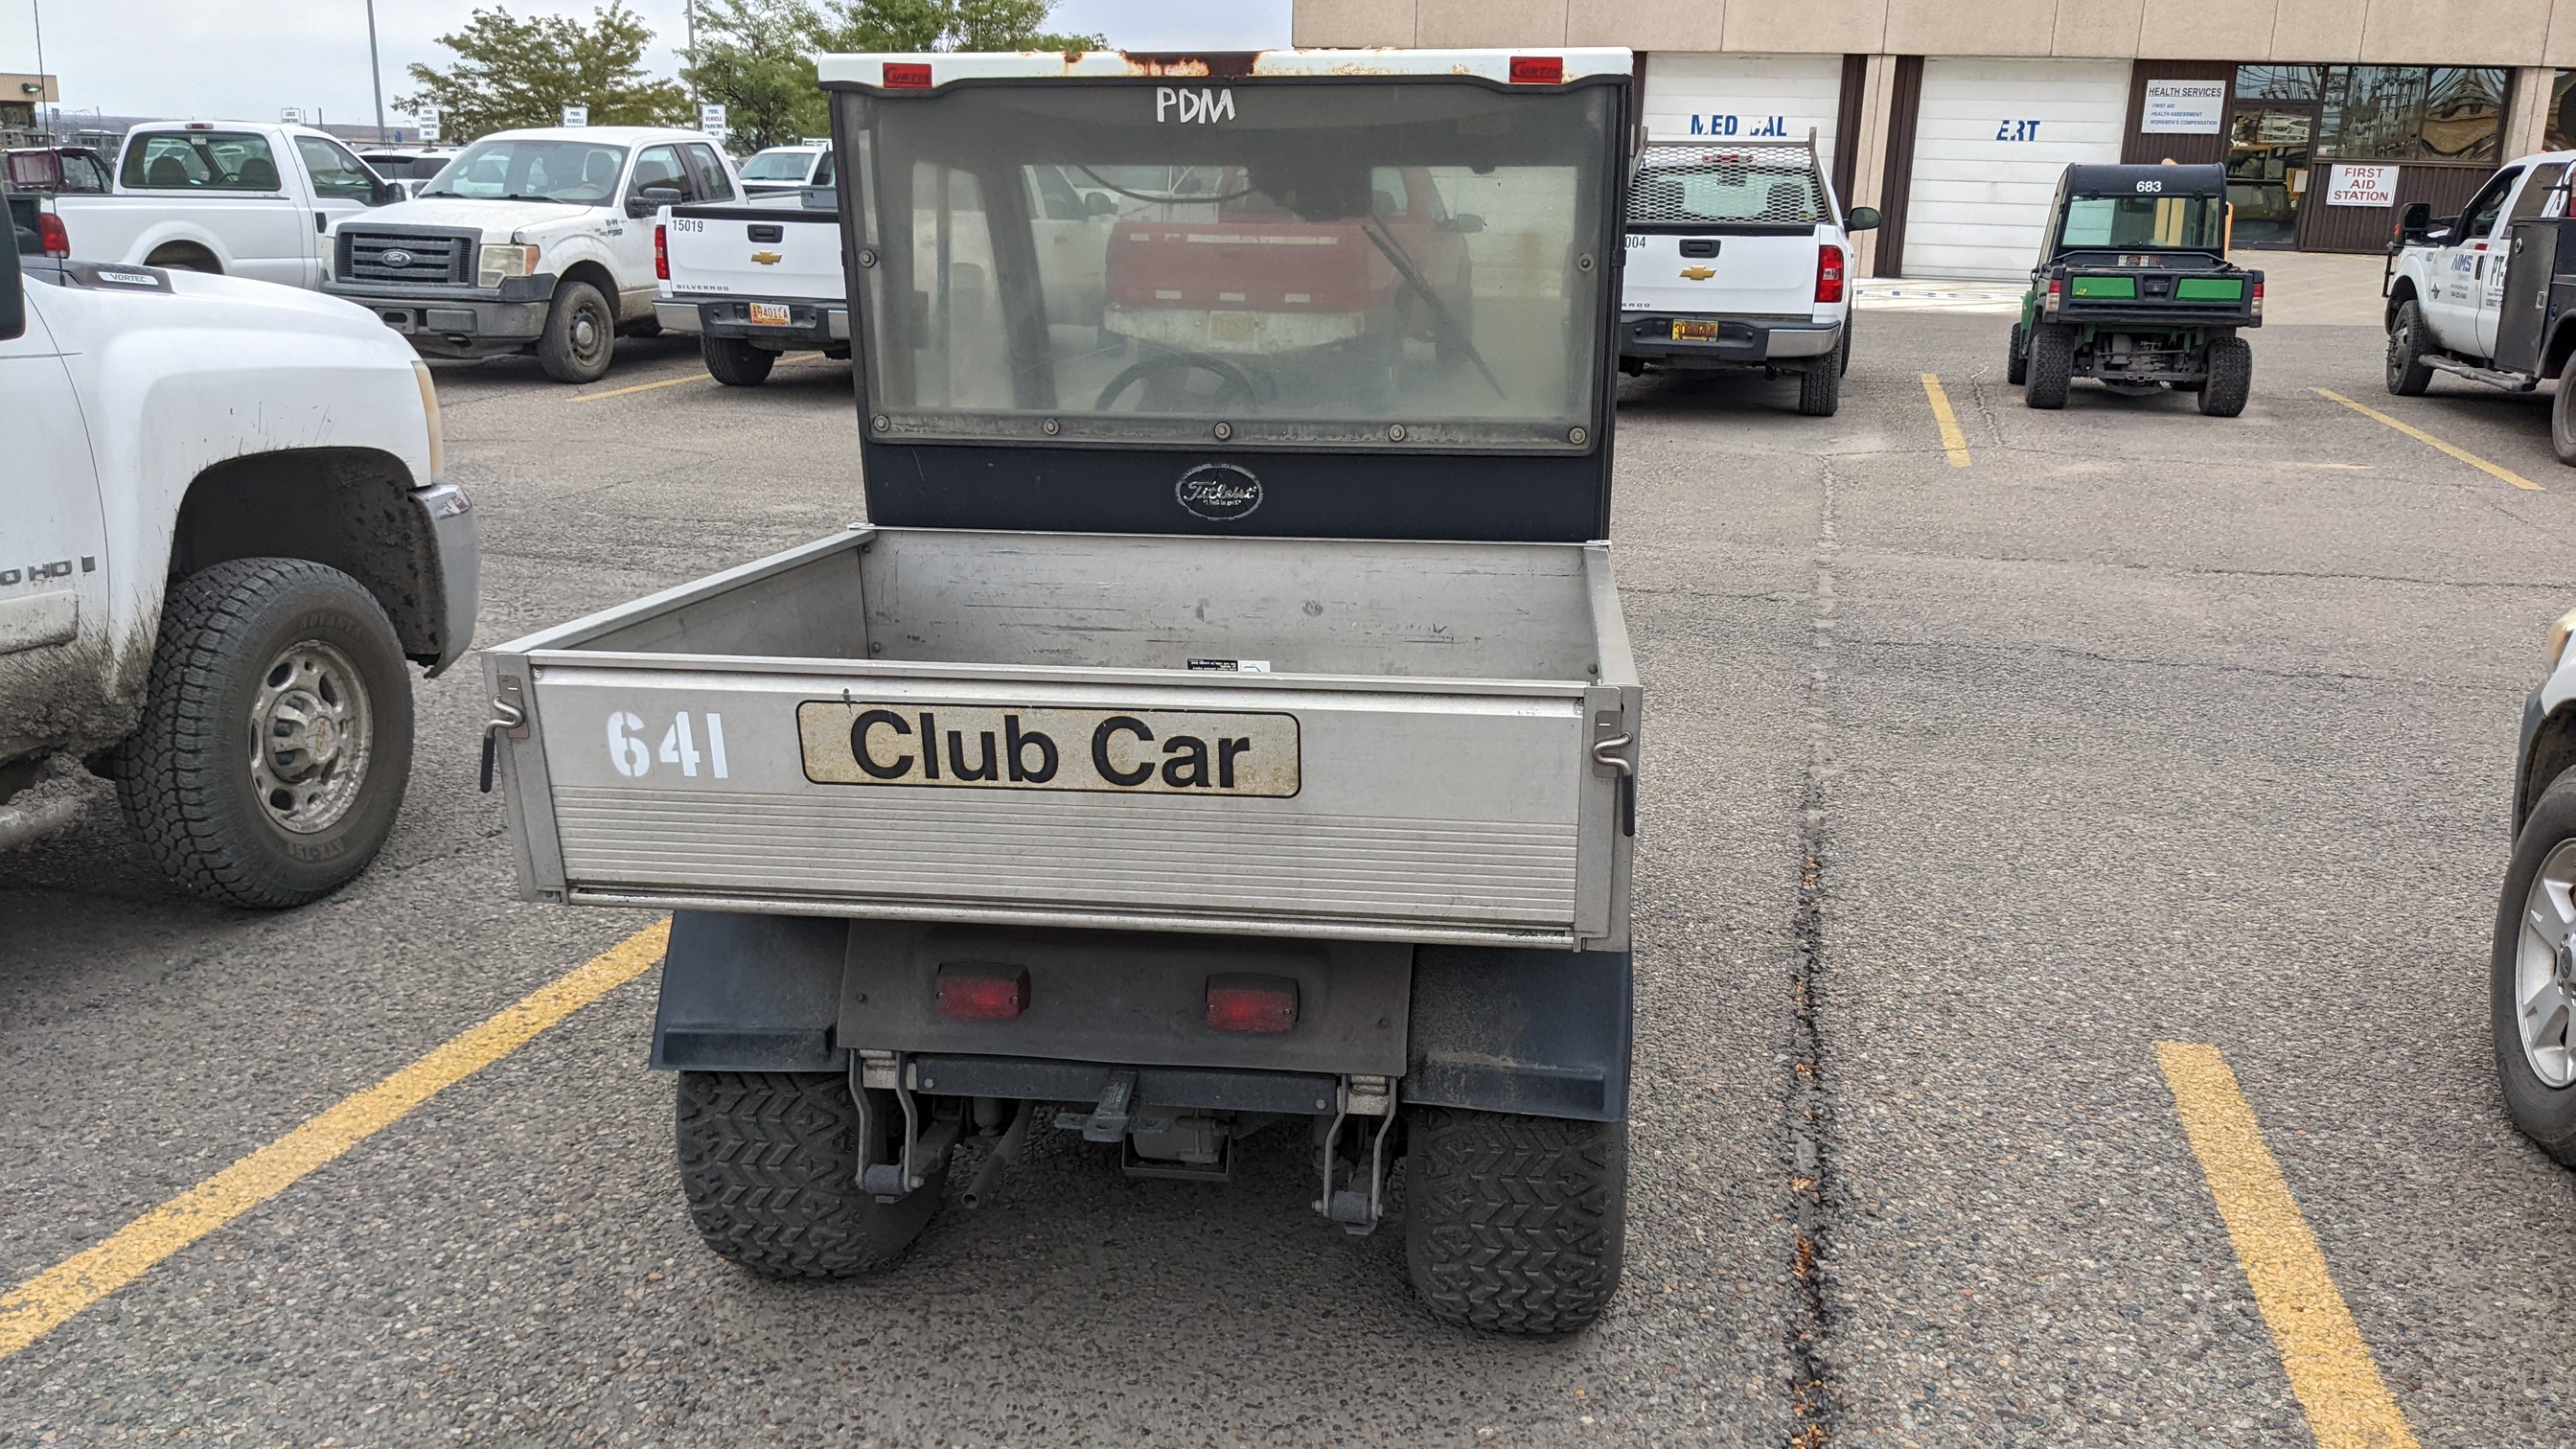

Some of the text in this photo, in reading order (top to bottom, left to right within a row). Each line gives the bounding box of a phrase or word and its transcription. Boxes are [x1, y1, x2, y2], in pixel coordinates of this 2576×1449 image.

[2149, 87, 2222, 97] HEALTH SERVICES
[1157, 86, 1235, 125] PDM
[2345, 168, 2384, 178] FIRST
[2136, 180, 2162, 193] 683
[2350, 179, 2376, 189] AID
[2334, 190, 2389, 201] STATION
[672, 218, 703, 233] 15019
[109, 273, 147, 283] VORTEC
[28, 560, 73, 582] HD
[607, 710, 729, 779] 641
[850, 709, 1250, 790] Club Car
